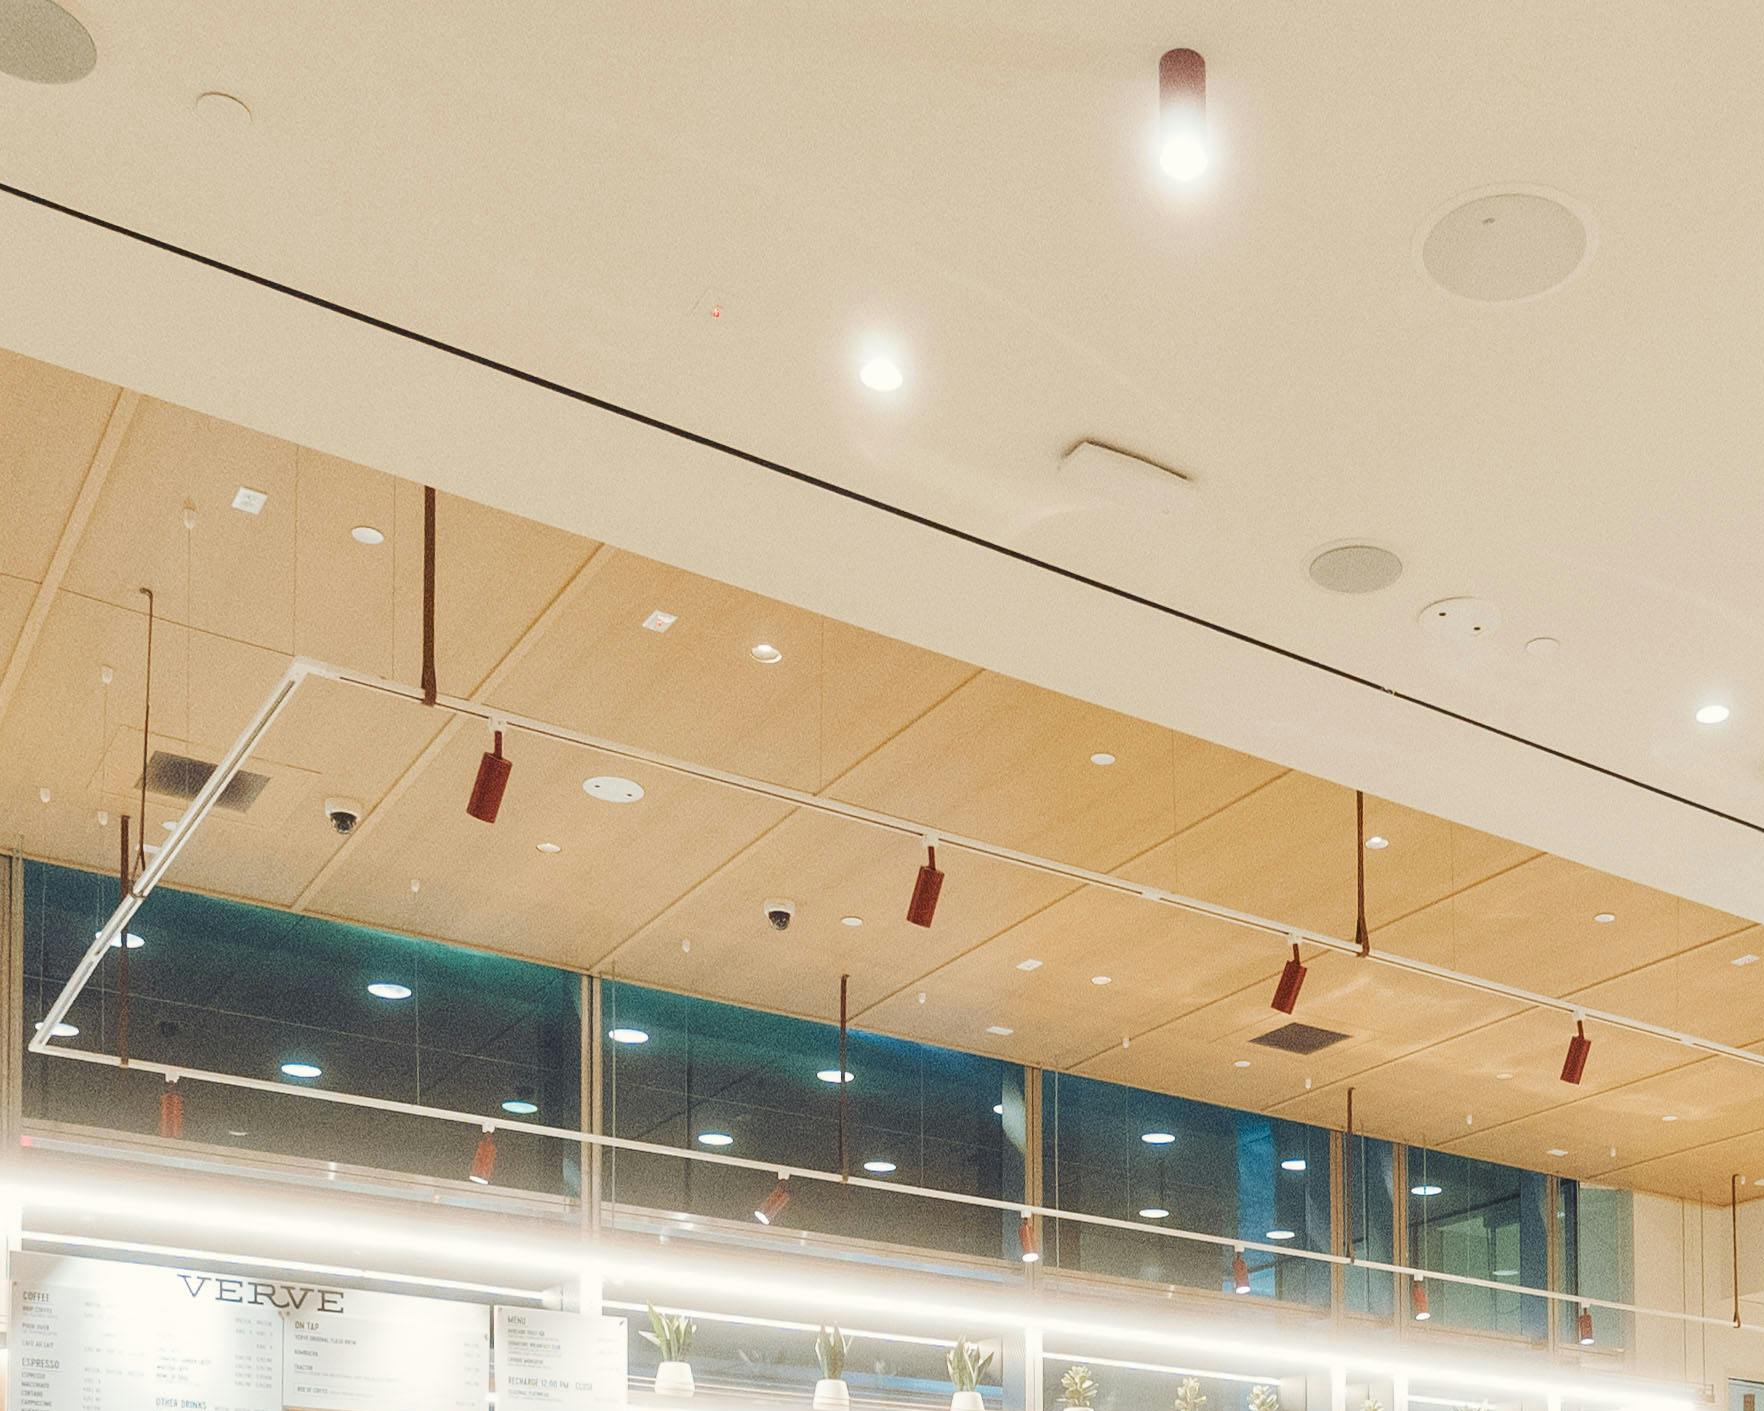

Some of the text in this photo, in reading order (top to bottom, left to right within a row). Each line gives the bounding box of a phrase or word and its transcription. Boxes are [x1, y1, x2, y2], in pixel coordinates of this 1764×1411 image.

[22, 1291, 49, 1302] COFFEE
[177, 1274, 344, 1314] VERVE
[507, 1315, 526, 1325] MENU
[294, 1321, 320, 1331] ON TAP
[21, 1358, 60, 1369] ESPRESSO
[155, 1398, 178, 1408] OTHER
